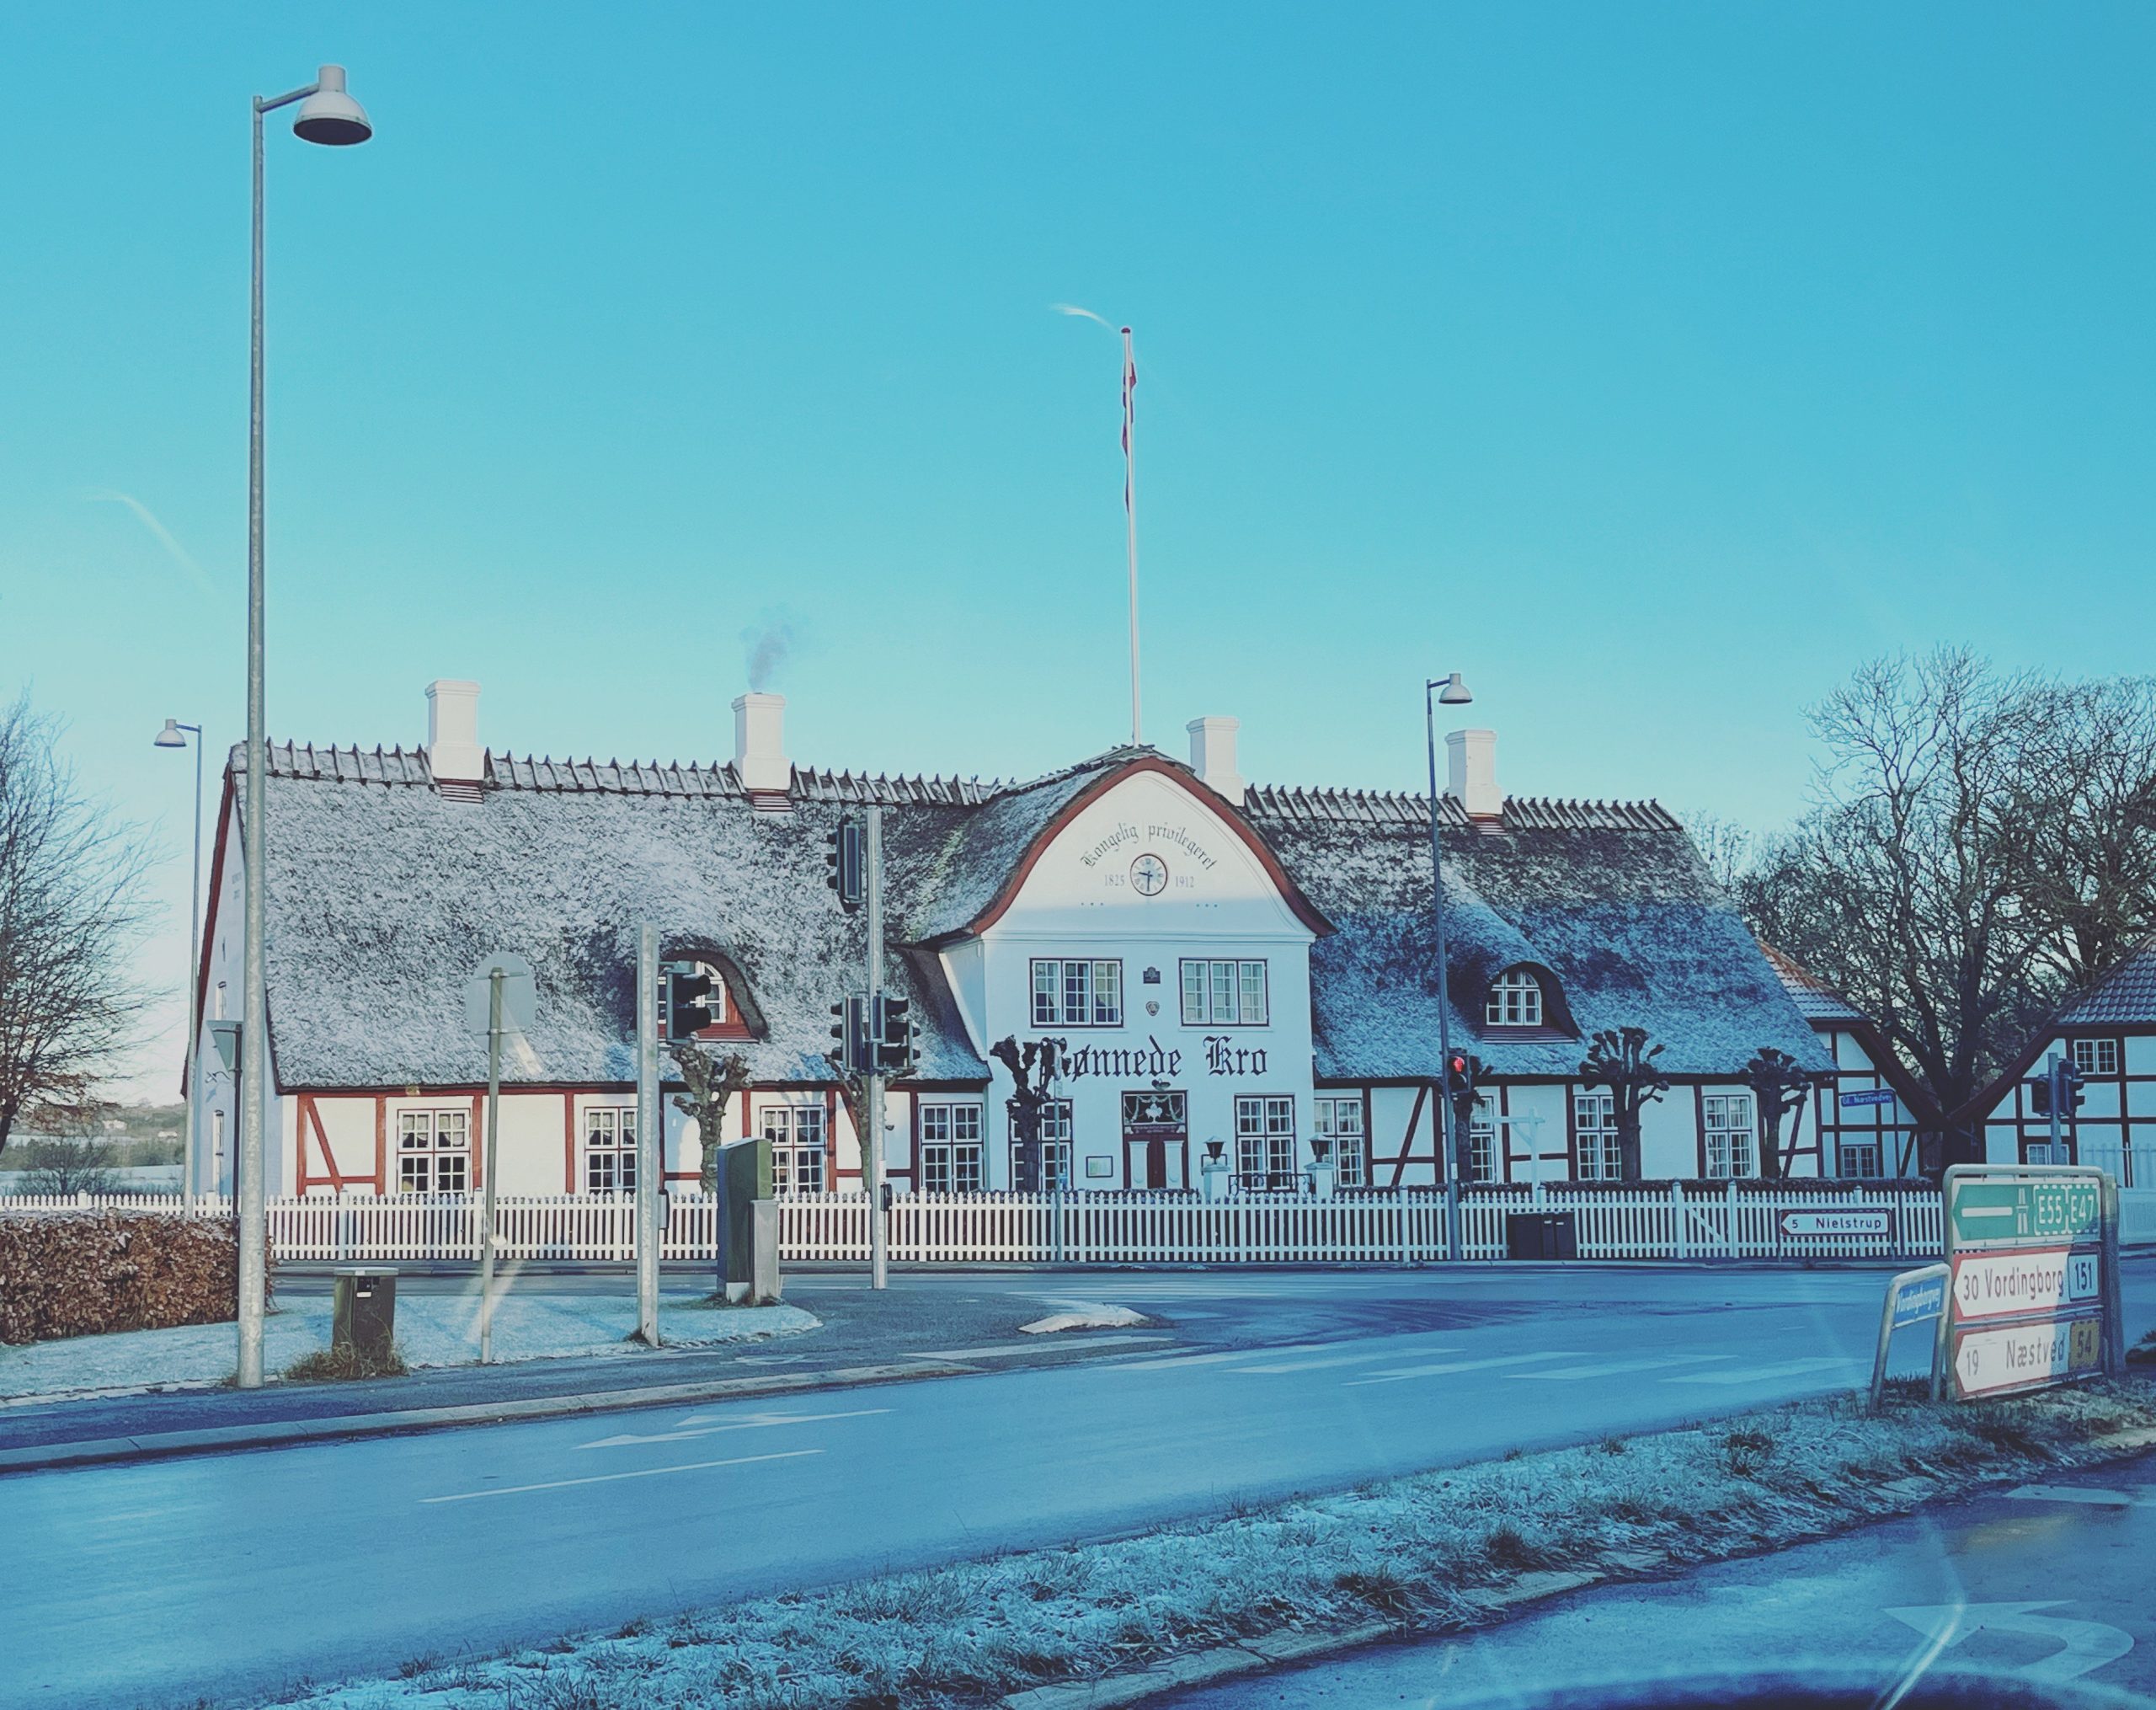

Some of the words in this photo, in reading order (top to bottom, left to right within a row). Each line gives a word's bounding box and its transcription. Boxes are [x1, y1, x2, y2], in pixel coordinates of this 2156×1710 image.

[1080, 822, 1139, 868] Kongelig
[1148, 821, 1218, 870] privilegeret
[1104, 874, 1125, 886] 1825
[1175, 875, 1195, 888] 1912
[1062, 1034, 1182, 1082] ønnede
[1203, 1035, 1268, 1077] Kro
[1791, 1219, 1798, 1229] 5
[1816, 1217, 1881, 1230] Nielstrup
[2038, 1195, 2062, 1225] E55
[2070, 1194, 2095, 1224] E47
[1963, 1274, 1979, 1301] 30
[1985, 1265, 2063, 1301] Vordingborg
[2075, 1262, 2093, 1291] 151
[1967, 1349, 1979, 1377] 19
[2006, 1333, 2063, 1371] Næstved
[2077, 1328, 2094, 1360] 54
